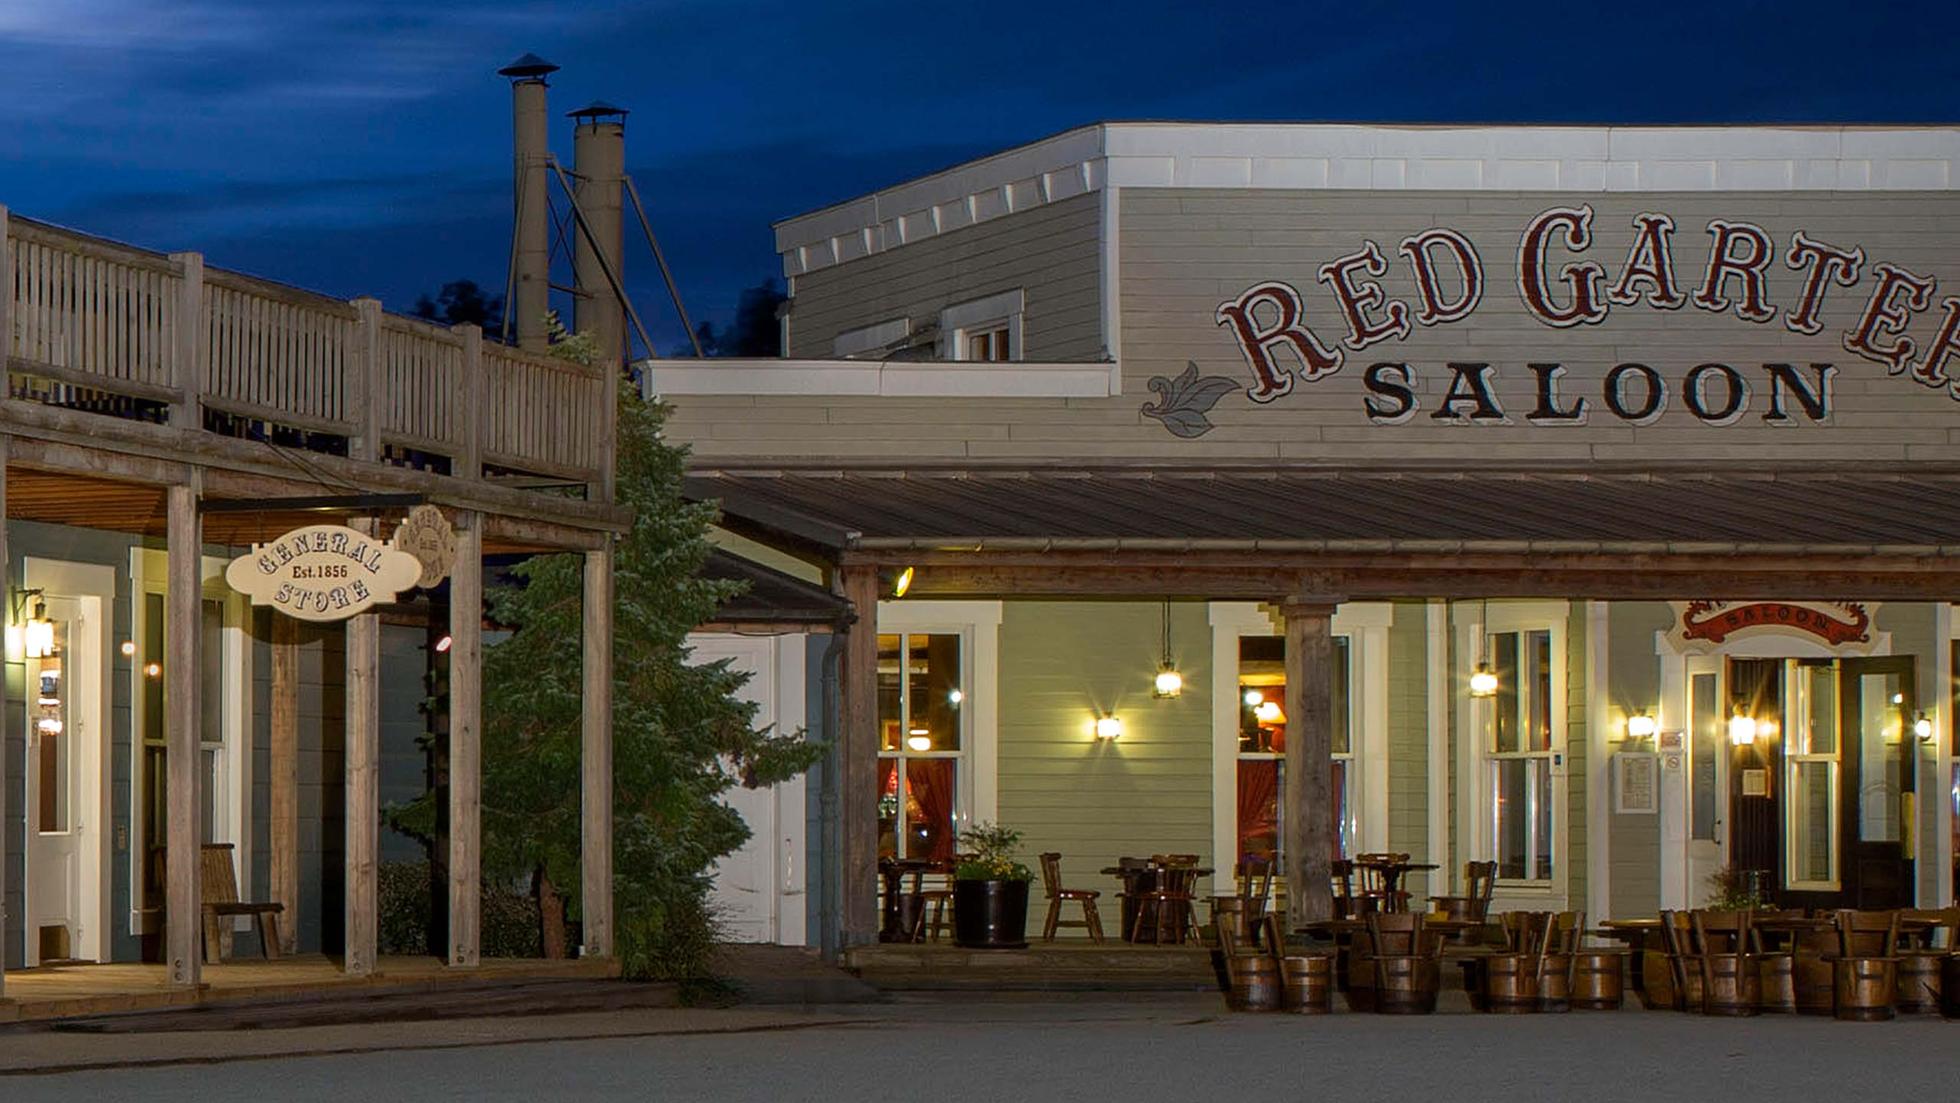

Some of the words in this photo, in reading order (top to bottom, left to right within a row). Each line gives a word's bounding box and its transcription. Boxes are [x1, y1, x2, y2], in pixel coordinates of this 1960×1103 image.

[1216, 227, 1488, 404] RED
[1363, 362, 1840, 427] SALOON
[257, 530, 381, 575] GENERAL
[274, 581, 371, 613] STORE
[1724, 606, 1829, 630] SALOON
